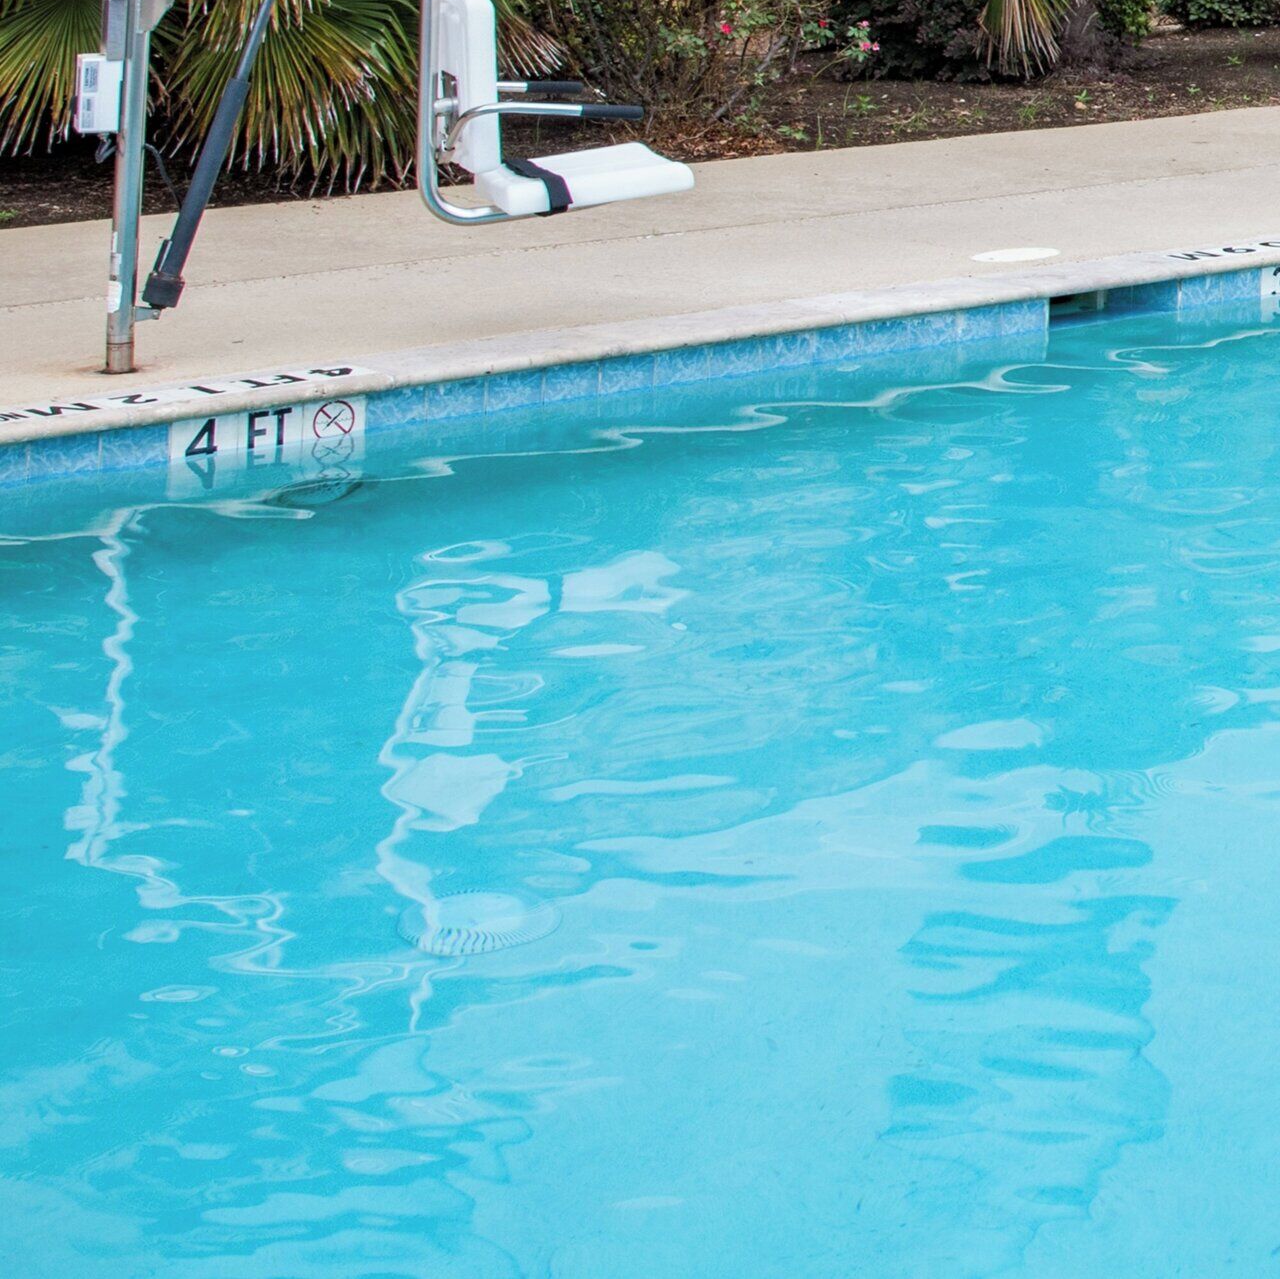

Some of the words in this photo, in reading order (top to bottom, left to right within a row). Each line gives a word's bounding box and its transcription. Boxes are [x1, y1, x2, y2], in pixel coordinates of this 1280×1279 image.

[25, 402, 101, 416] M
[185, 418, 218, 457] 4
[248, 407, 292, 449] FT
